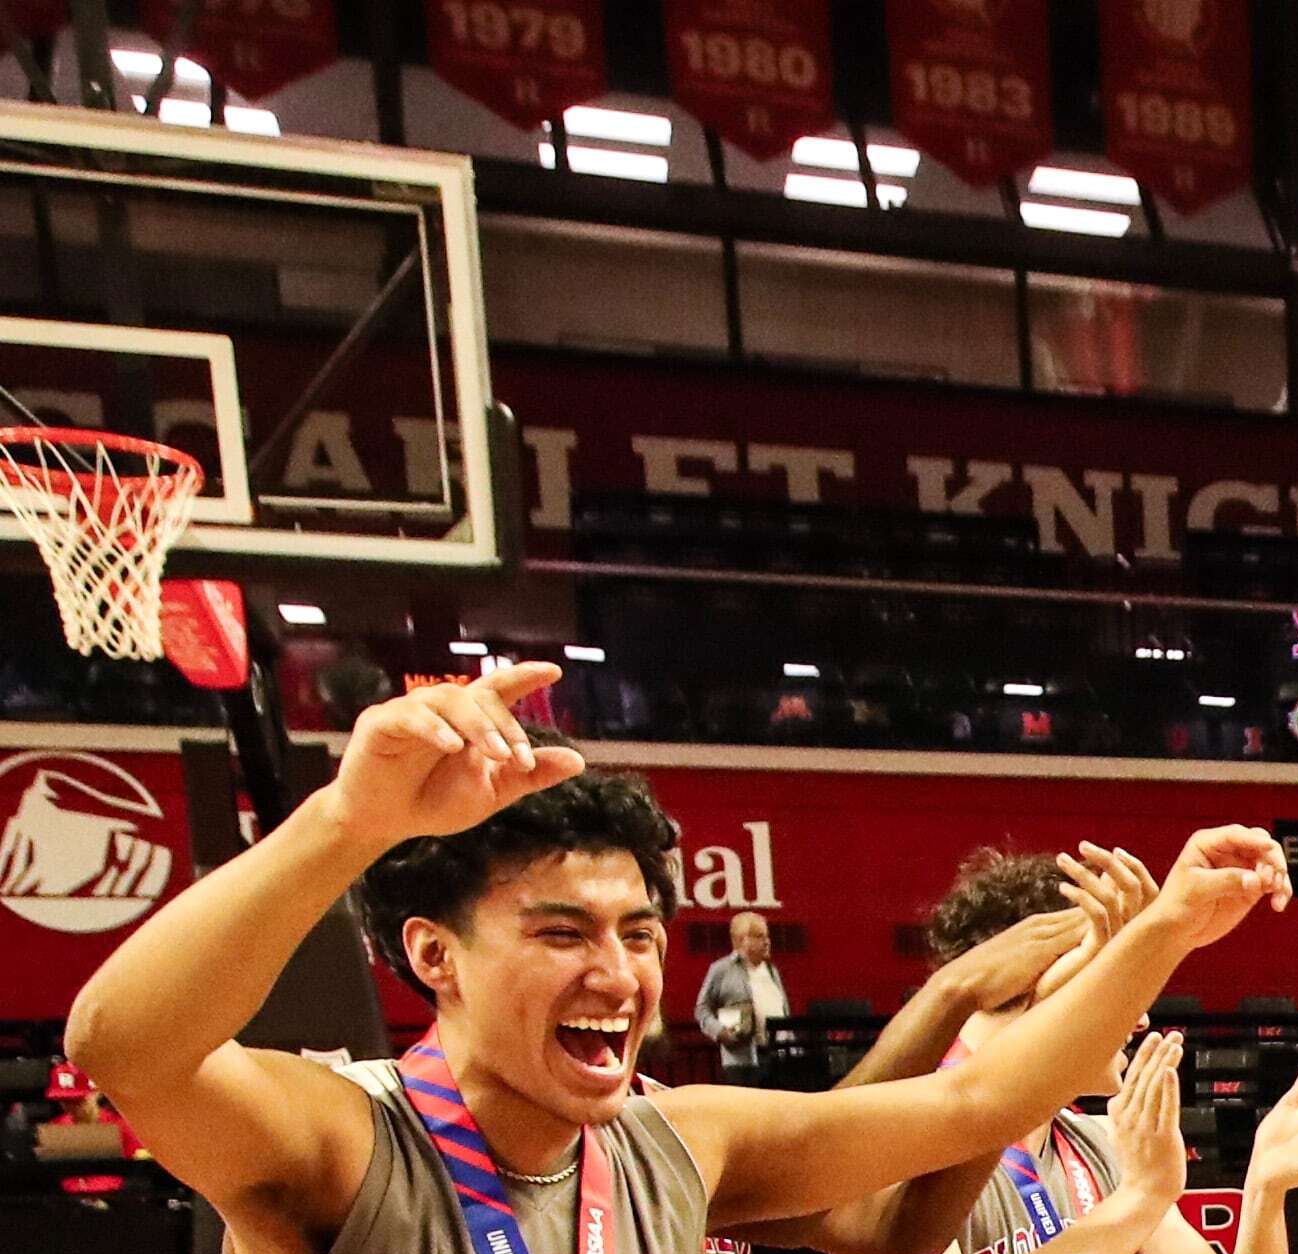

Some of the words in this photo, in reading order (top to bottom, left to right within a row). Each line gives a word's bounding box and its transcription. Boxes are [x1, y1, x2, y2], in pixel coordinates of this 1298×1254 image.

[445, 3, 586, 59] 1979
[681, 30, 818, 89] 1980
[1030, 1192, 1056, 1236] UNIFIED
